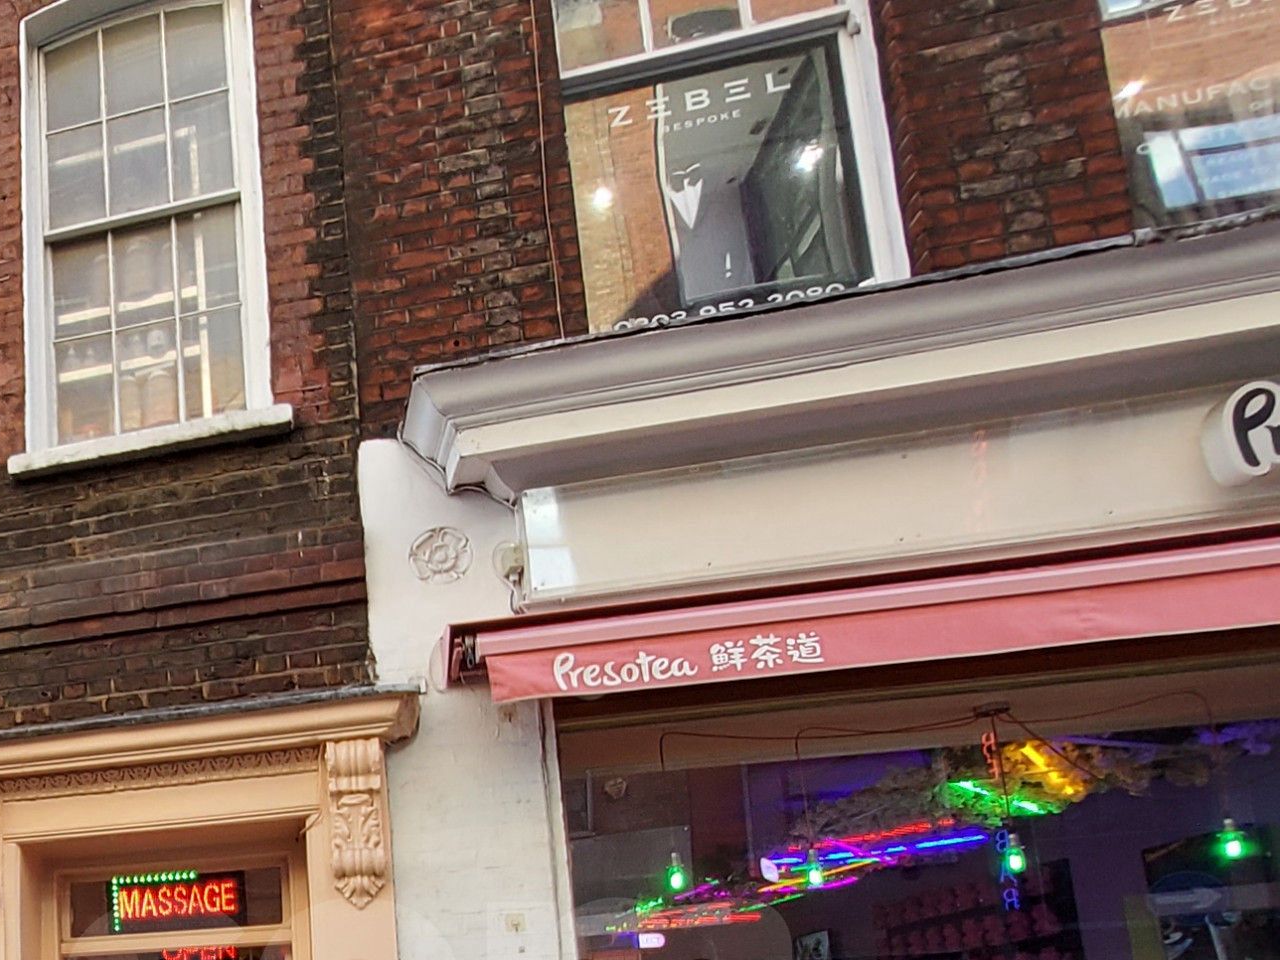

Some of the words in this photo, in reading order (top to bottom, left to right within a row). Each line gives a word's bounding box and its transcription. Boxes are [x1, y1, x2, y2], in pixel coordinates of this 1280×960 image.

[608, 73, 791, 127] ZEBEL
[663, 109, 742, 133] BESPOKE
[553, 652, 699, 691] Presotea
[710, 632, 824, 672] 鮮茶道
[119, 880, 236, 920] MASSAGE
